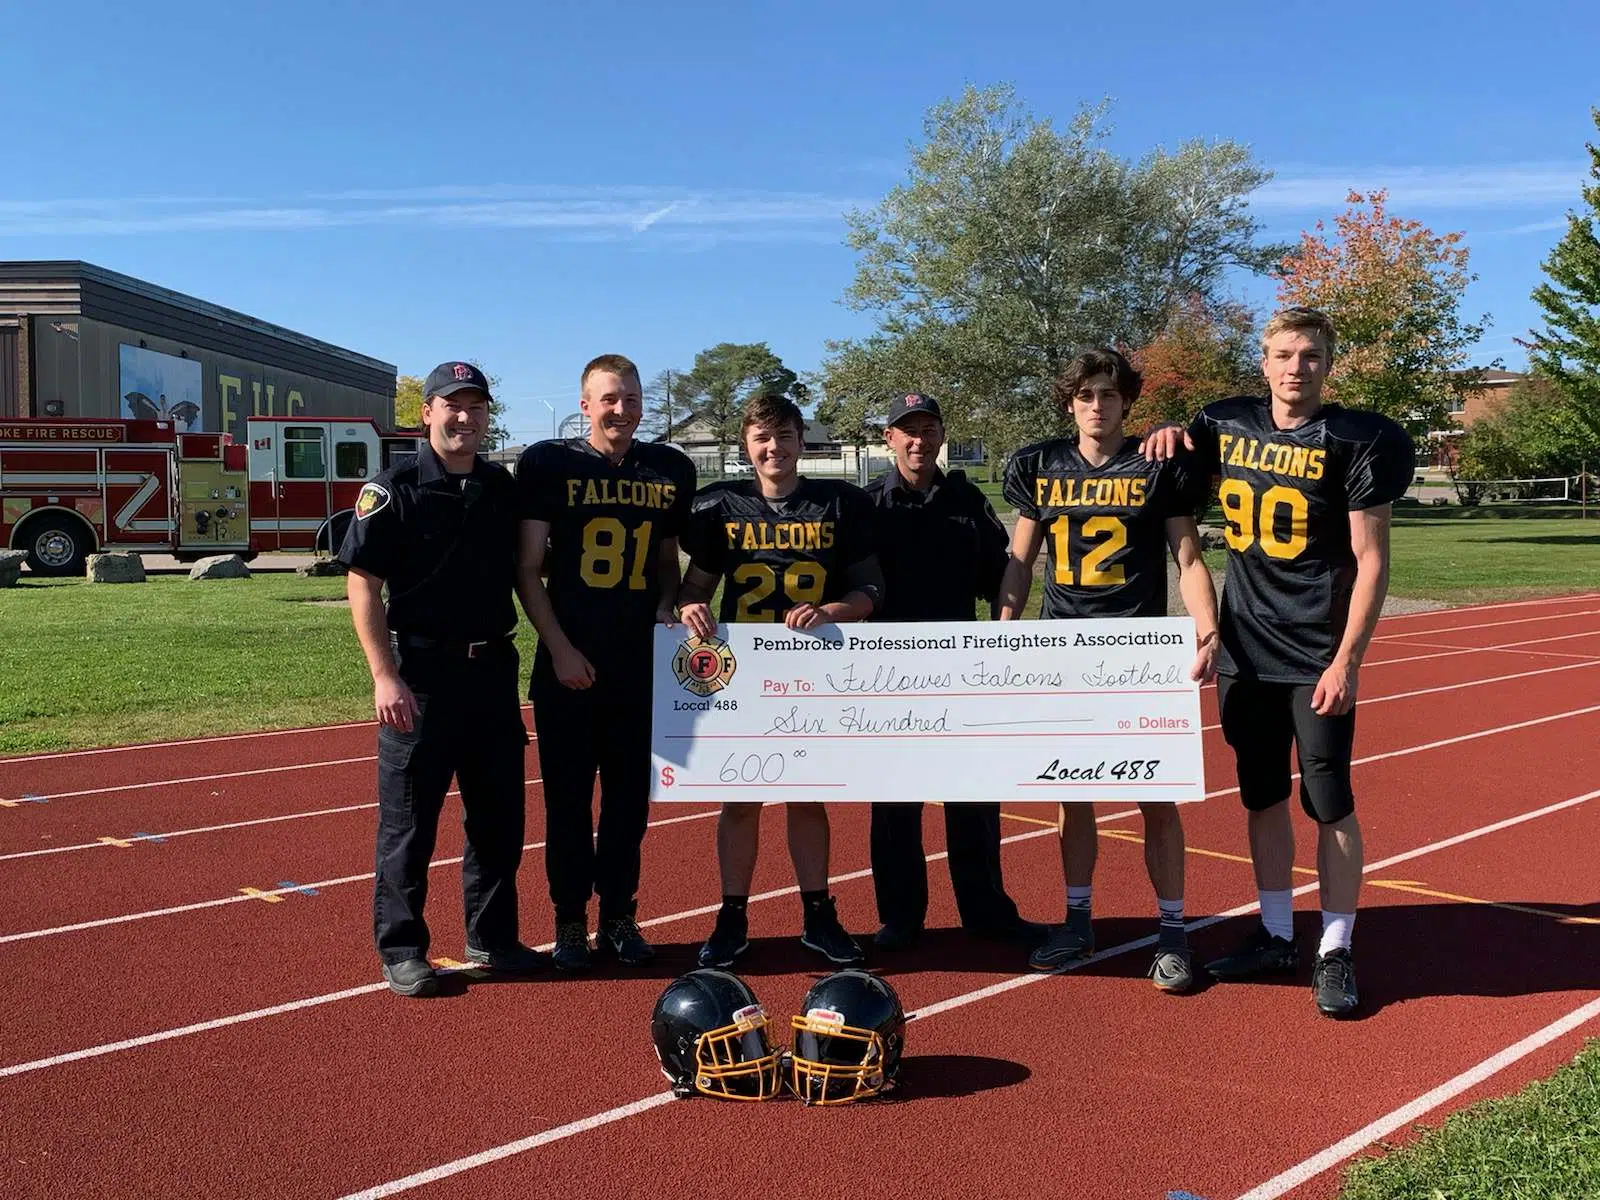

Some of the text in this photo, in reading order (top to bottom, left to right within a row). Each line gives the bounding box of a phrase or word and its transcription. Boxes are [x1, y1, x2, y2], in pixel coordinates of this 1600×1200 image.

[0, 428, 114, 439] KE FIRE RESCUE
[1218, 434, 1326, 480] FALCONS
[567, 479, 677, 509] FALCONS
[1036, 478, 1147, 507] FALCONS
[1218, 478, 1308, 560] 90
[725, 521, 835, 550] FALCONS
[1050, 514, 1128, 586] 12
[580, 517, 652, 590] 81
[753, 632, 1183, 651] Pembroke Professional Firefighters Association
[763, 680, 815, 695] Pay To:
[961, 661, 1063, 687] Falcons
[1082, 661, 1183, 687] Football
[673, 700, 738, 711] Local 488
[764, 705, 951, 735] Six Hundred
[1139, 716, 1189, 729] Dollars
[661, 766, 675, 788] $
[719, 752, 785, 783] 600
[1036, 759, 1160, 781] Local 488
